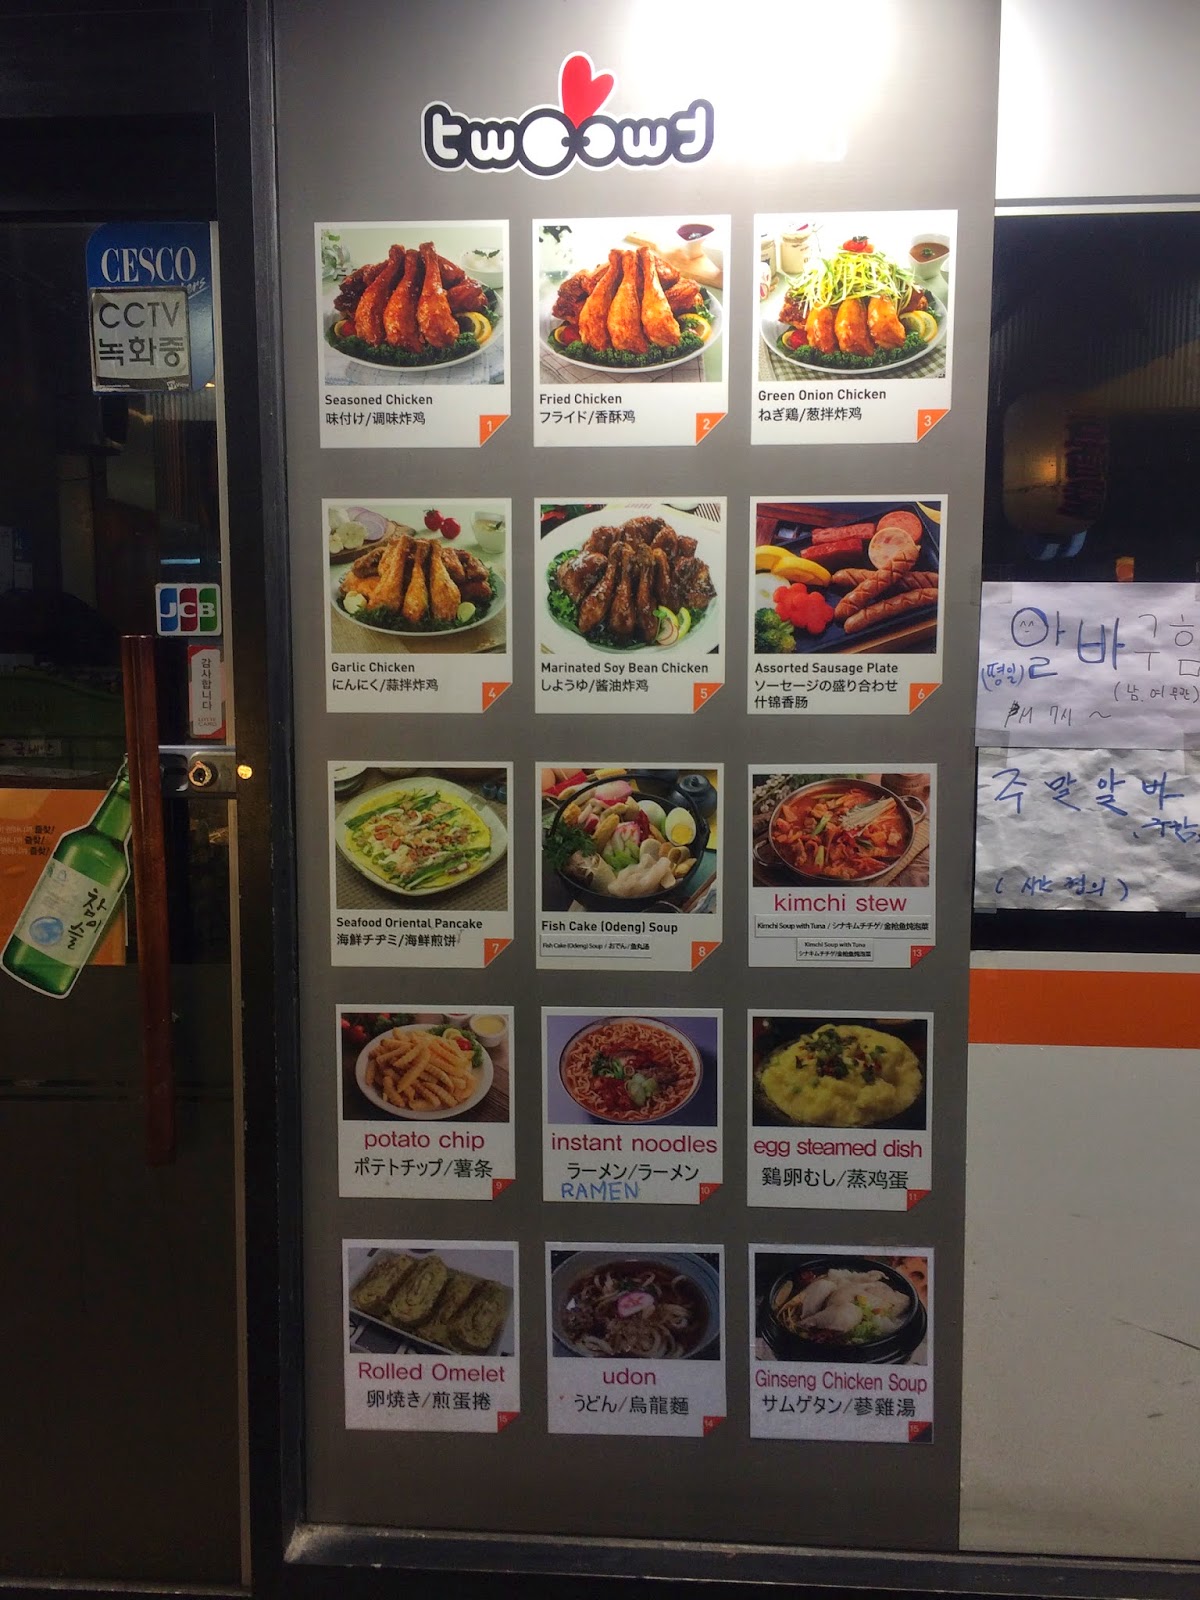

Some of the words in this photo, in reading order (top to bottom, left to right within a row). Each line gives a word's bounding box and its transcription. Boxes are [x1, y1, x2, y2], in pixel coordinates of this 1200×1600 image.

[101, 246, 197, 283] CESCO
[98, 301, 180, 329] CCTV
[98, 336, 185, 368] 녹화중
[325, 394, 382, 405] Seasoned
[385, 394, 433, 405] Chicken
[539, 393, 571, 404] Fried
[574, 393, 622, 404] Chicken
[758, 390, 795, 401] Green
[799, 389, 834, 401] Onion
[837, 388, 887, 400] Chicken
[486, 420, 492, 432] 1
[702, 418, 710, 430] 2
[924, 414, 932, 427] 3
[160, 602, 216, 618] JCB
[331, 662, 366, 673] Garlic
[369, 662, 415, 673] Chicken
[541, 662, 601, 673] Marinated
[604, 662, 626, 675] Soy
[628, 662, 658, 673] Bean
[661, 662, 709, 673] Chicken
[755, 662, 809, 673] Assorted
[812, 662, 864, 676] Sausage
[866, 662, 898, 673] Plate
[201, 658, 212, 711] 감사합니다
[755, 679, 898, 693] ソーセージの盛り合わせ
[488, 688, 496, 698] 4
[700, 688, 708, 699] 5
[918, 688, 926, 700] 6
[774, 894, 846, 912] kimchi
[856, 894, 907, 912] stew
[67, 887, 107, 950] 참이슬
[336, 917, 382, 928] Seafood
[385, 918, 432, 928] Oriental
[434, 918, 483, 929] Pancake
[541, 920, 566, 932] Fish
[569, 921, 598, 932] Cake
[649, 922, 678, 934] Soup
[758, 922, 778, 930] Kimchi
[778, 922, 795, 930] Soup
[796, 922, 810, 930] with
[810, 922, 826, 930] Tuna
[492, 943, 500, 954] 7
[698, 946, 706, 957] 8
[912, 949, 922, 958] 13
[364, 1131, 430, 1150] potato
[438, 1131, 485, 1152] chip
[552, 1133, 622, 1151] instant
[632, 1135, 718, 1153] noodles
[754, 1140, 790, 1158] egg
[796, 1138, 876, 1156] steamed
[883, 1139, 922, 1158] dish
[354, 1157, 493, 1178] ポテトチップ/薯条
[567, 1162, 700, 1181] ラーメン/ラーメン
[561, 1182, 639, 1200] RAMEN
[700, 1187, 710, 1195] 10
[358, 1362, 422, 1380] Rolled
[432, 1363, 505, 1382] Omelet
[602, 1368, 657, 1385] udon
[755, 1369, 817, 1392] Ginseng
[822, 1370, 882, 1391] Chicken
[888, 1373, 928, 1396] Soup
[910, 1424, 920, 1433] 15
